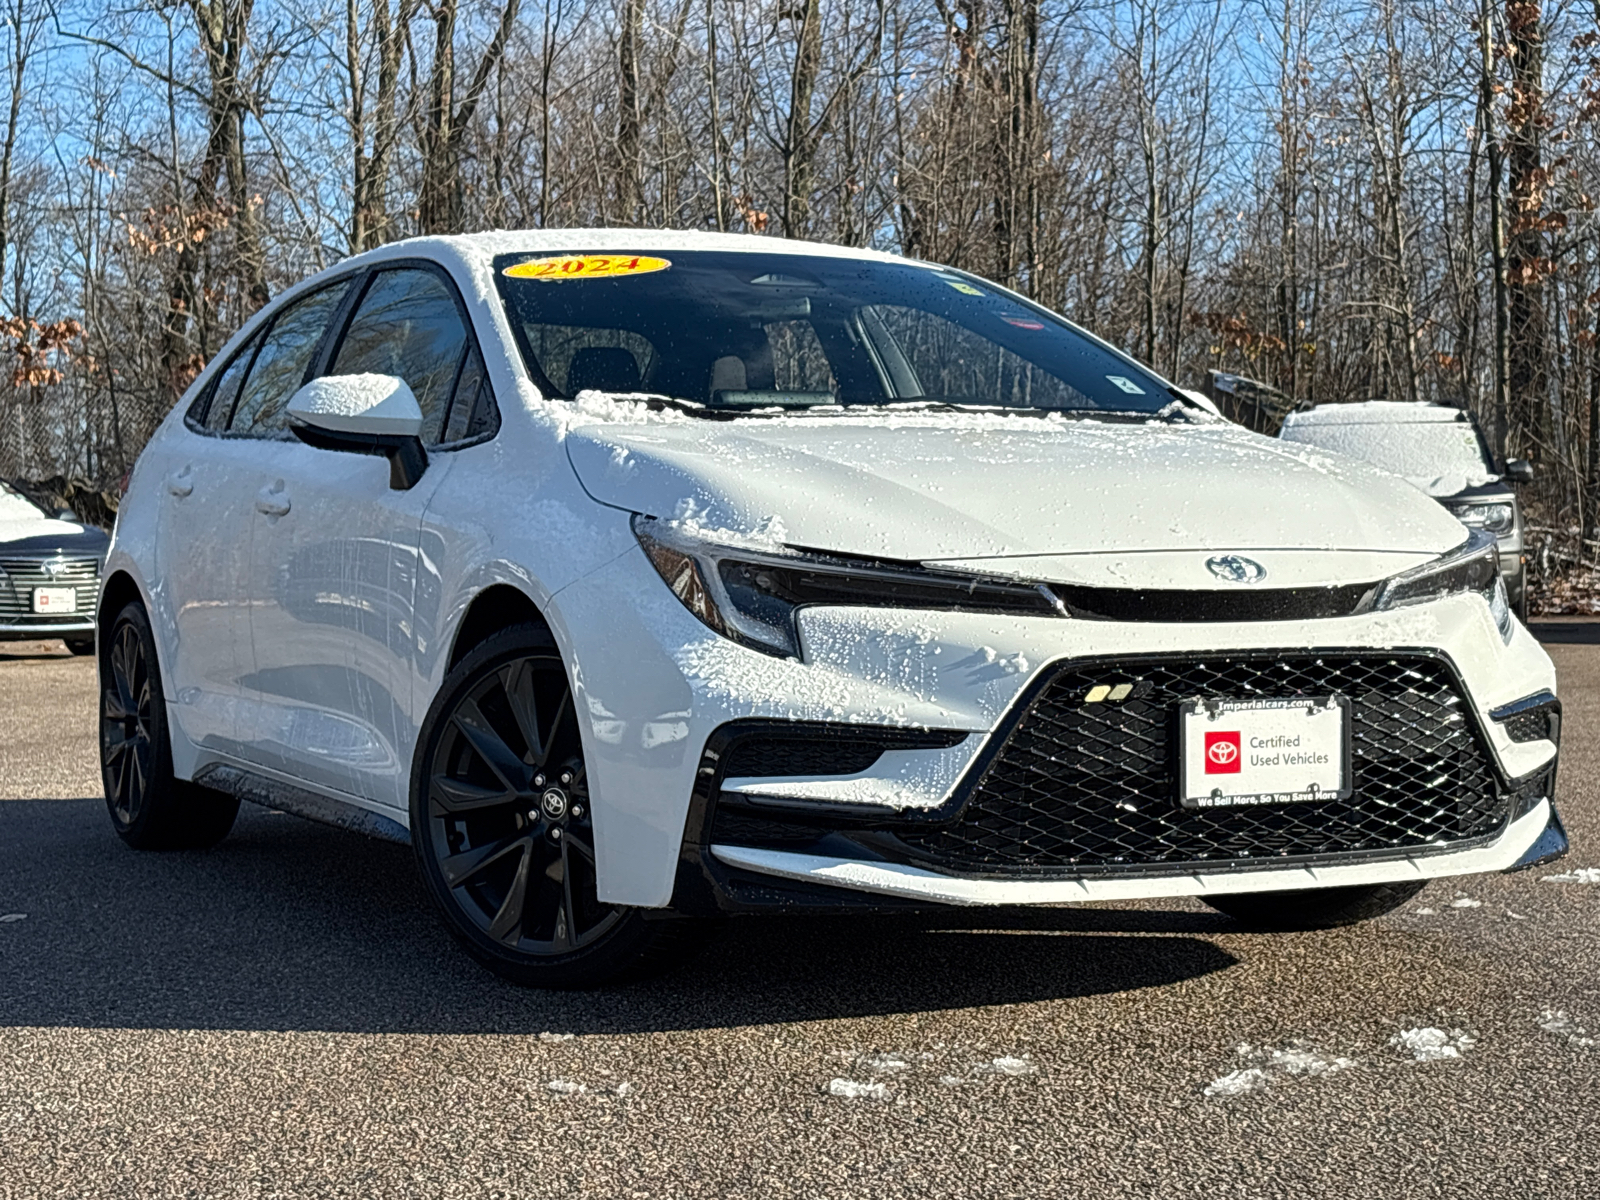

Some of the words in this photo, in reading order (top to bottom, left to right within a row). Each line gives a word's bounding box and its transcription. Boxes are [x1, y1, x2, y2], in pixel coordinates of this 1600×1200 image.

[535, 258, 640, 276] 2024
[1250, 735, 1300, 748] Certified
[1250, 753, 1280, 766] Used
[1283, 752, 1329, 765] Vehicles
[1197, 797, 1213, 807] We
[1214, 796, 1231, 806] Sell
[1233, 795, 1258, 806] More,
[1260, 794, 1272, 804] So
[1273, 793, 1290, 803] You
[1292, 792, 1313, 801] Save
[1315, 790, 1337, 801] More
